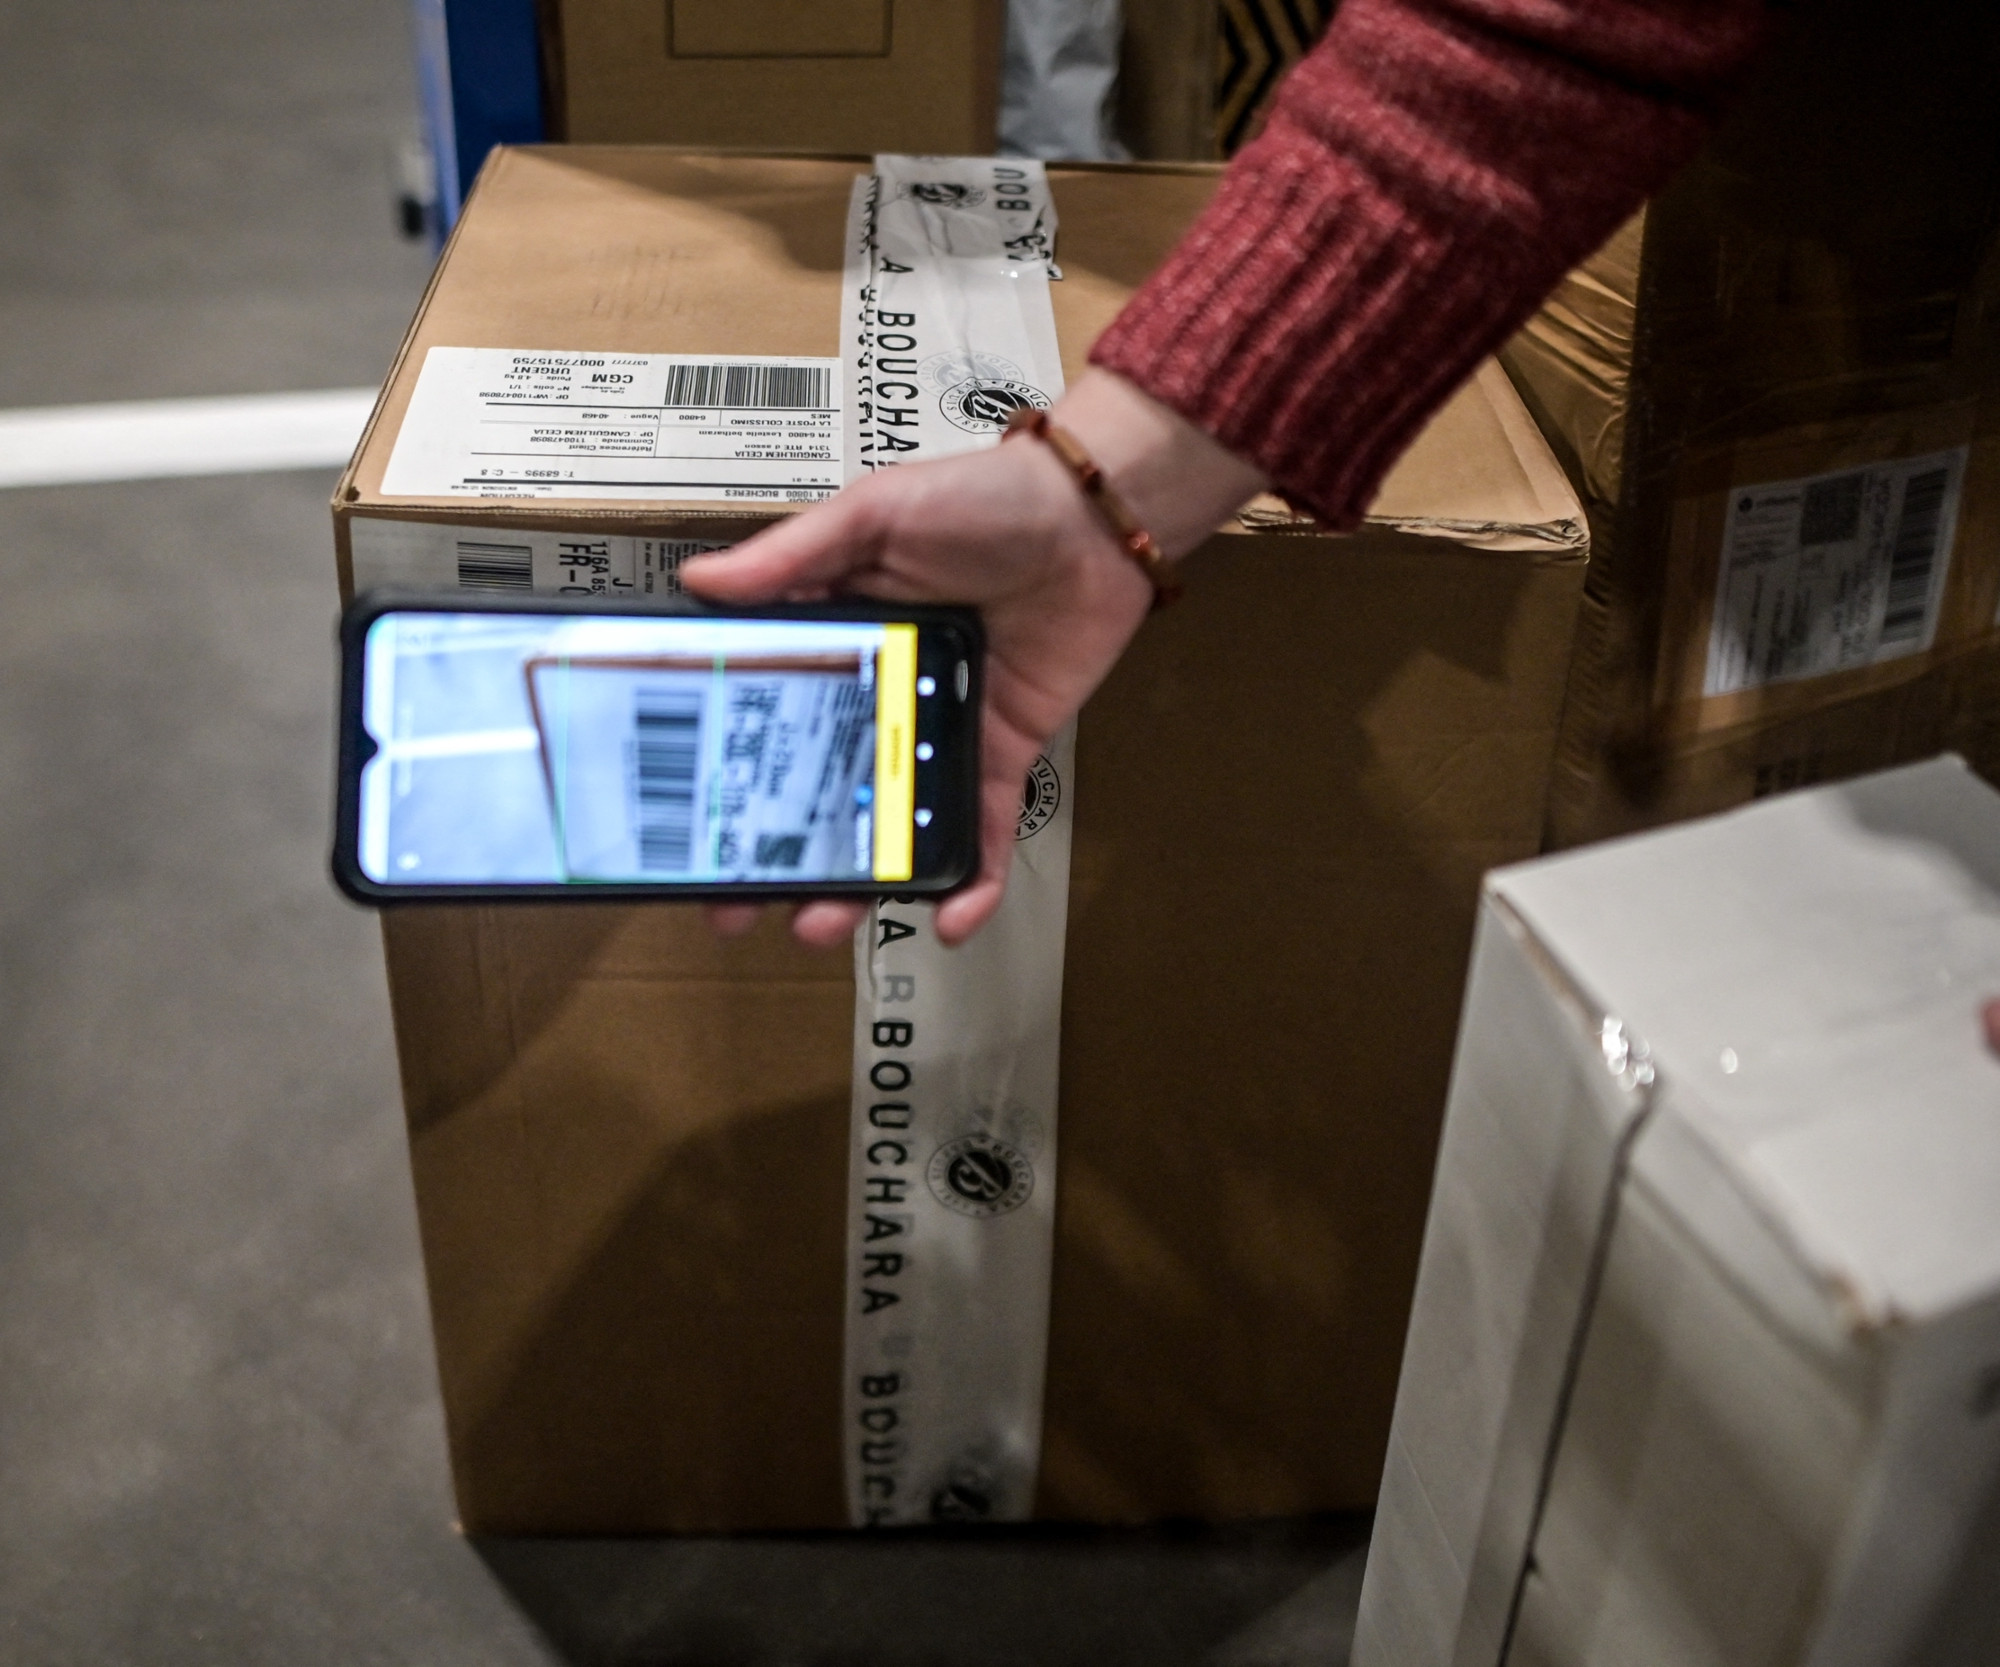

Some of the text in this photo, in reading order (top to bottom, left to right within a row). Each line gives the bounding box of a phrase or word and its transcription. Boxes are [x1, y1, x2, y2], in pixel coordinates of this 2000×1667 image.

[512, 357, 604, 366] 00077515759
[512, 367, 570, 375] URGENT
[591, 374, 634, 383] CGM
[765, 451, 831, 459] CANGUILHEM
[786, 490, 813, 498] 10800
[592, 541, 609, 574] 116A
[863, 1021, 914, 1315] BOUCHARA
